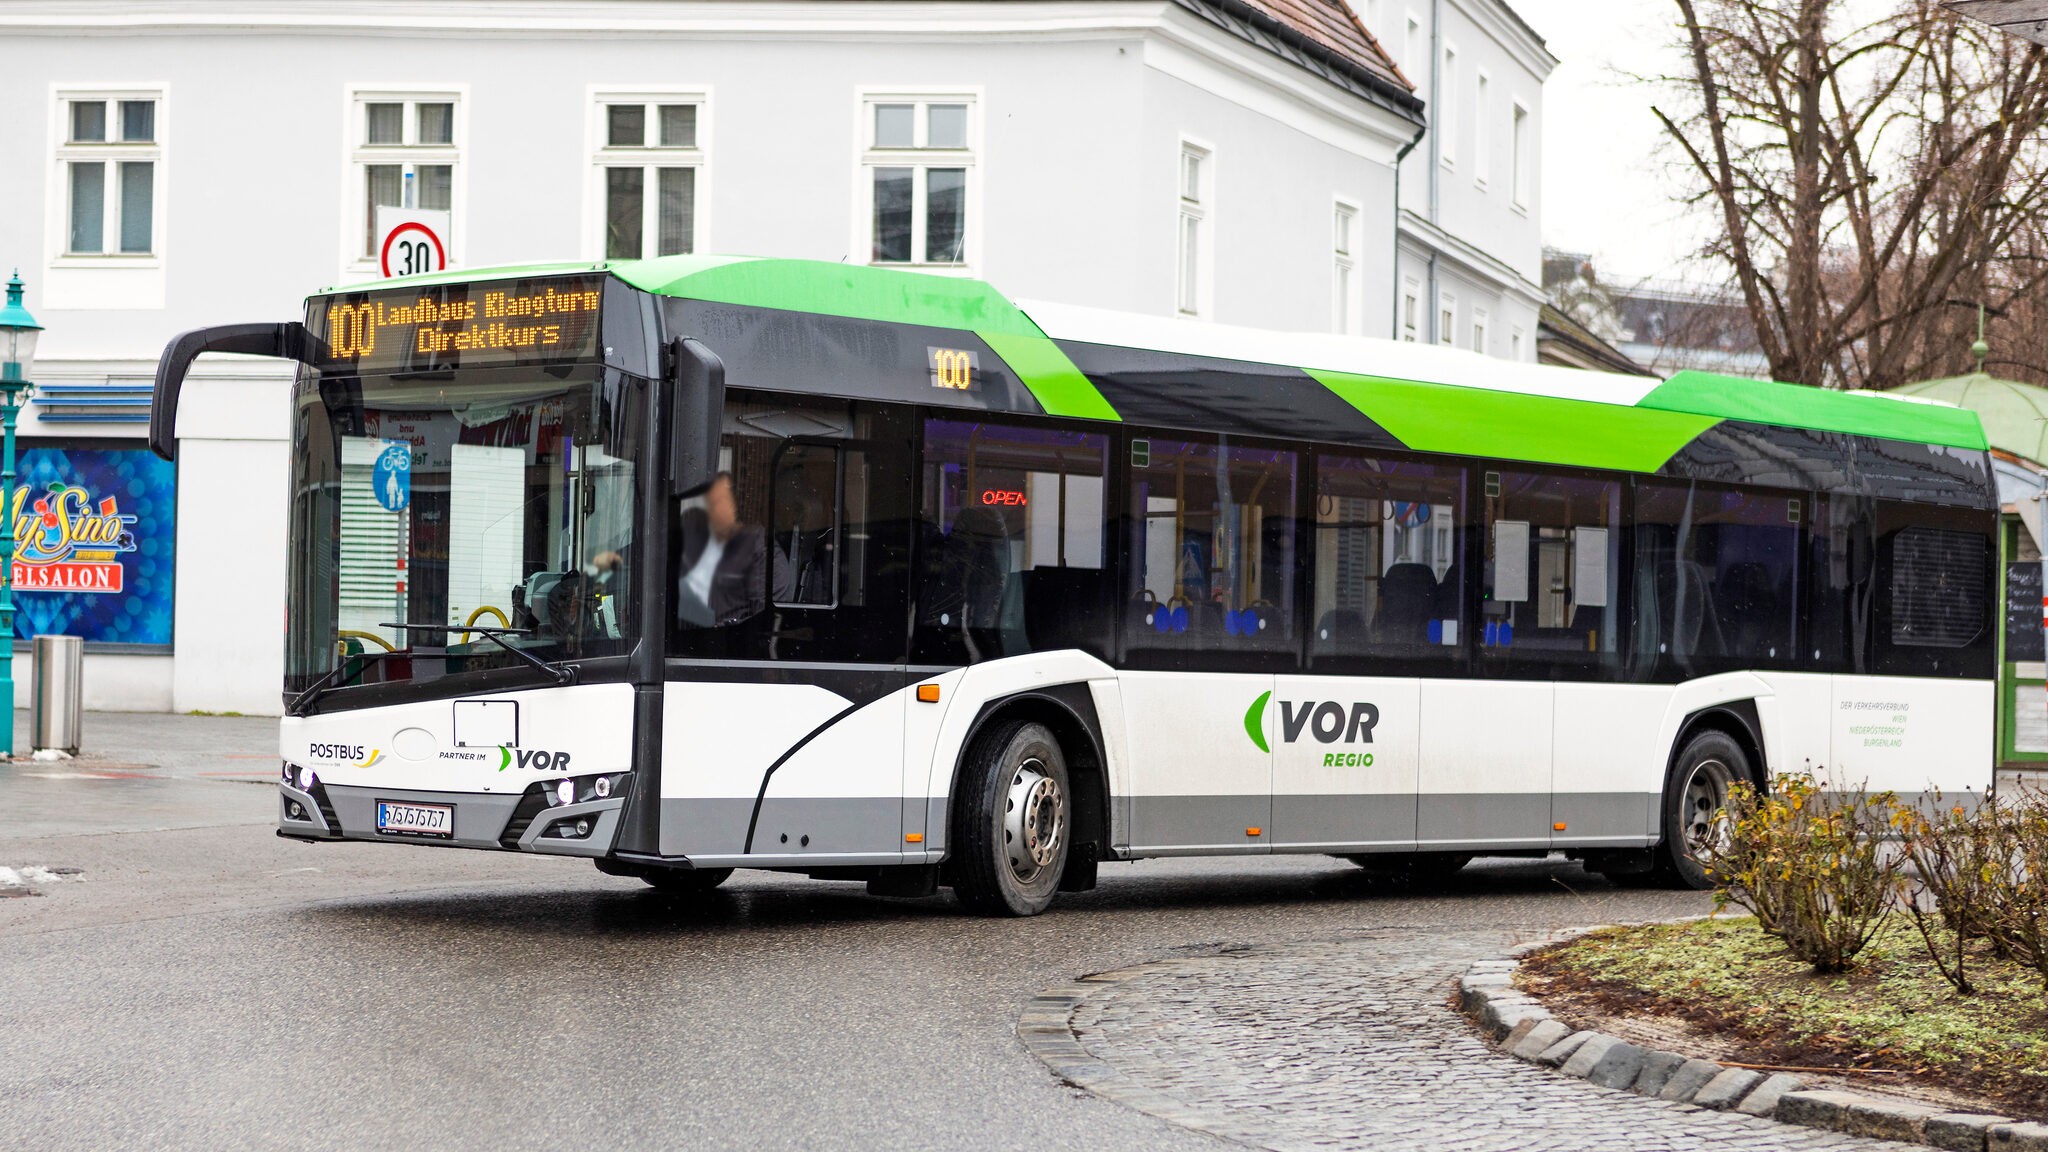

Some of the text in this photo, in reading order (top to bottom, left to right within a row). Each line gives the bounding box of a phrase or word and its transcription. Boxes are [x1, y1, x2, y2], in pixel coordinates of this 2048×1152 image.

[398, 240, 430, 275] 30
[377, 297, 477, 327] Landhaus
[328, 302, 375, 359] 100
[417, 323, 560, 353] Direktkurs
[934, 347, 972, 390] 100
[982, 489, 1027, 506] OPEN
[13, 566, 111, 588] ELSALON
[1277, 701, 1380, 744] VOR
[310, 743, 364, 760] POSTBUS
[439, 751, 487, 761] PARTNER IM
[515, 749, 571, 771] VOR
[1323, 753, 1374, 768] REGIO
